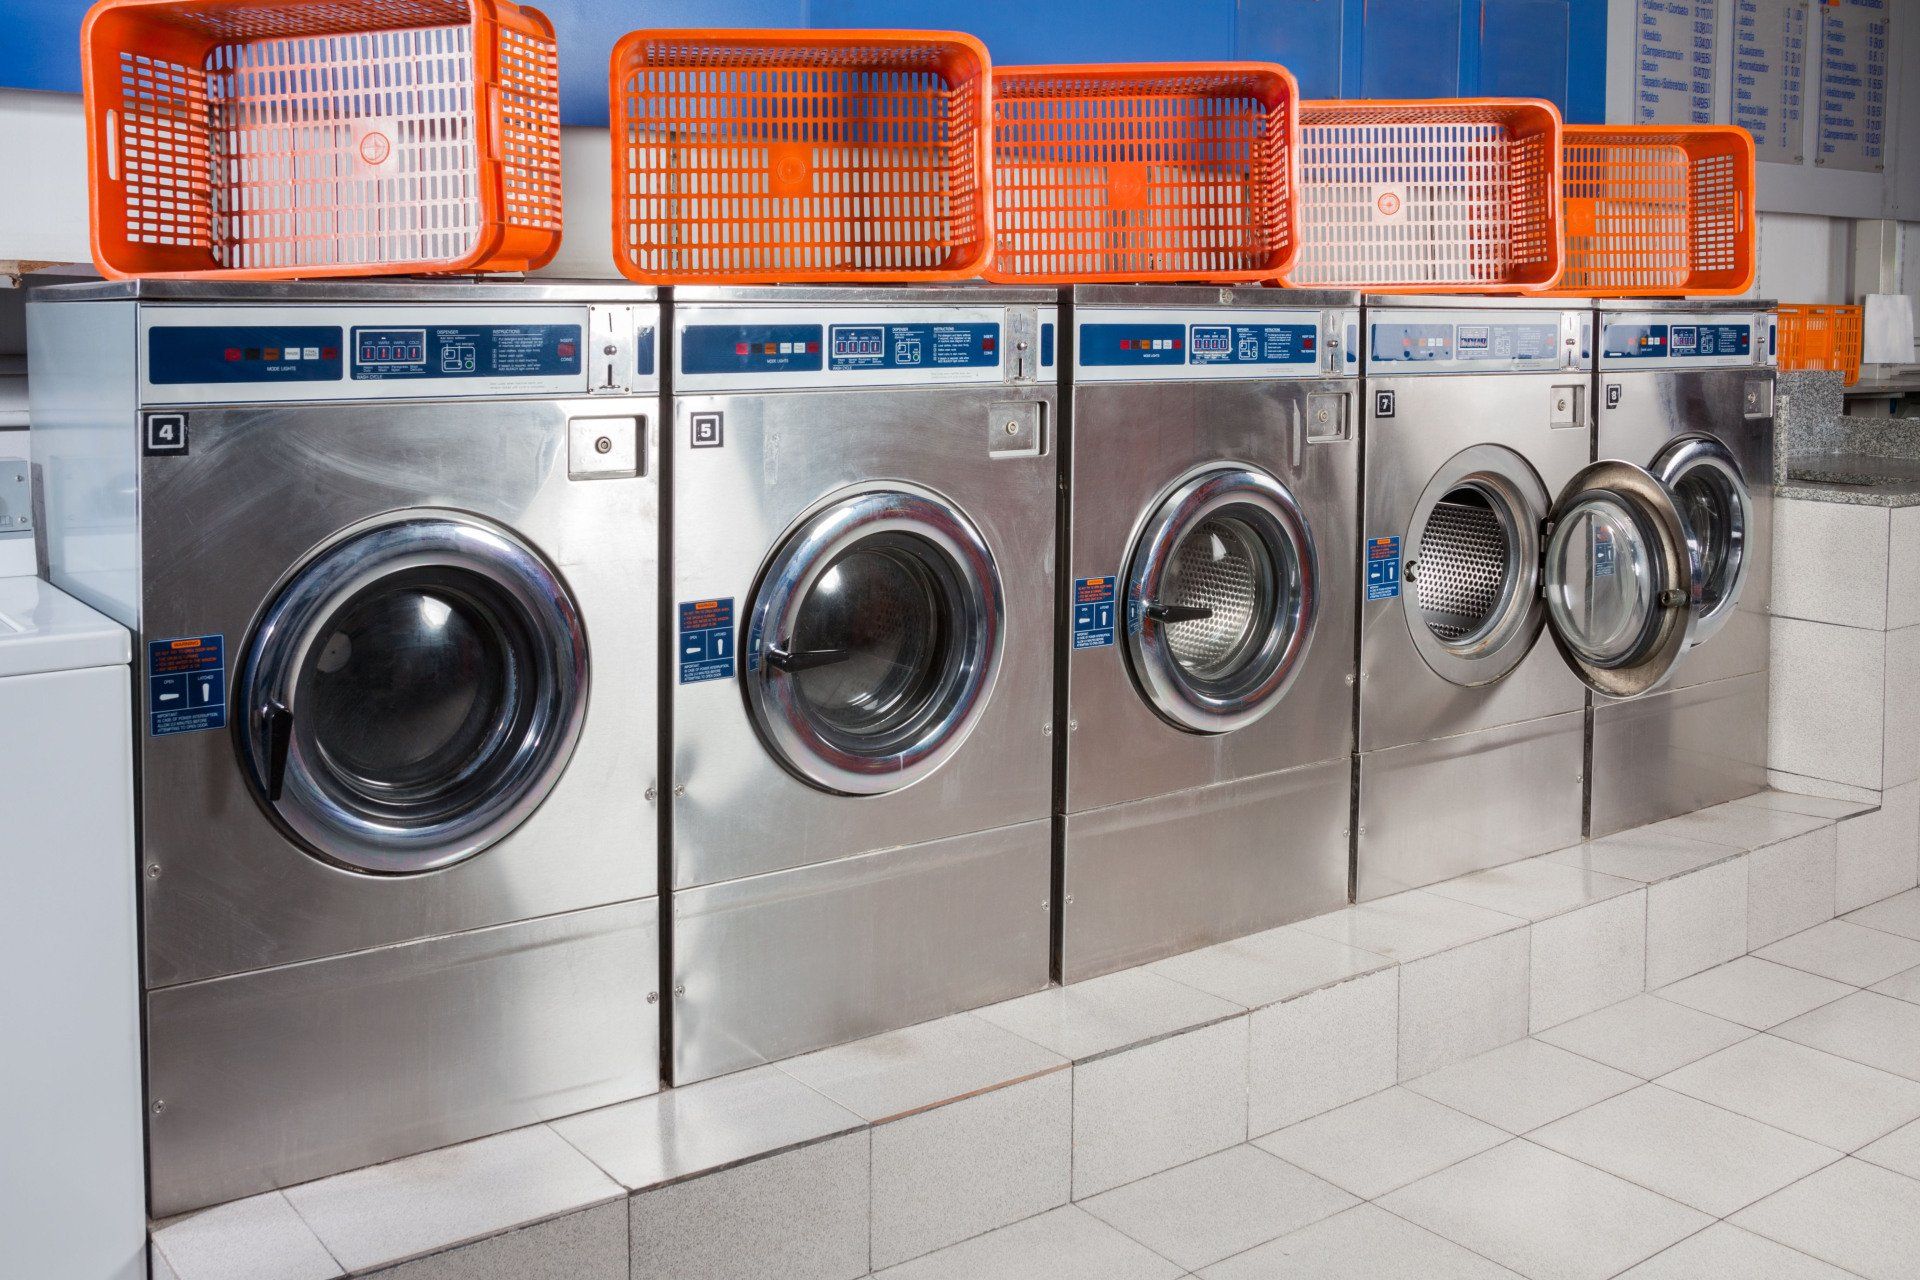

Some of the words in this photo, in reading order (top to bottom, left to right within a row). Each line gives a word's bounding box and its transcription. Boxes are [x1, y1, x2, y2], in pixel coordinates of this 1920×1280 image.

[1611, 391, 1616, 400] 8
[1382, 398, 1388, 410] 7
[159, 425, 174, 440] 4
[701, 423, 711, 438] 5
